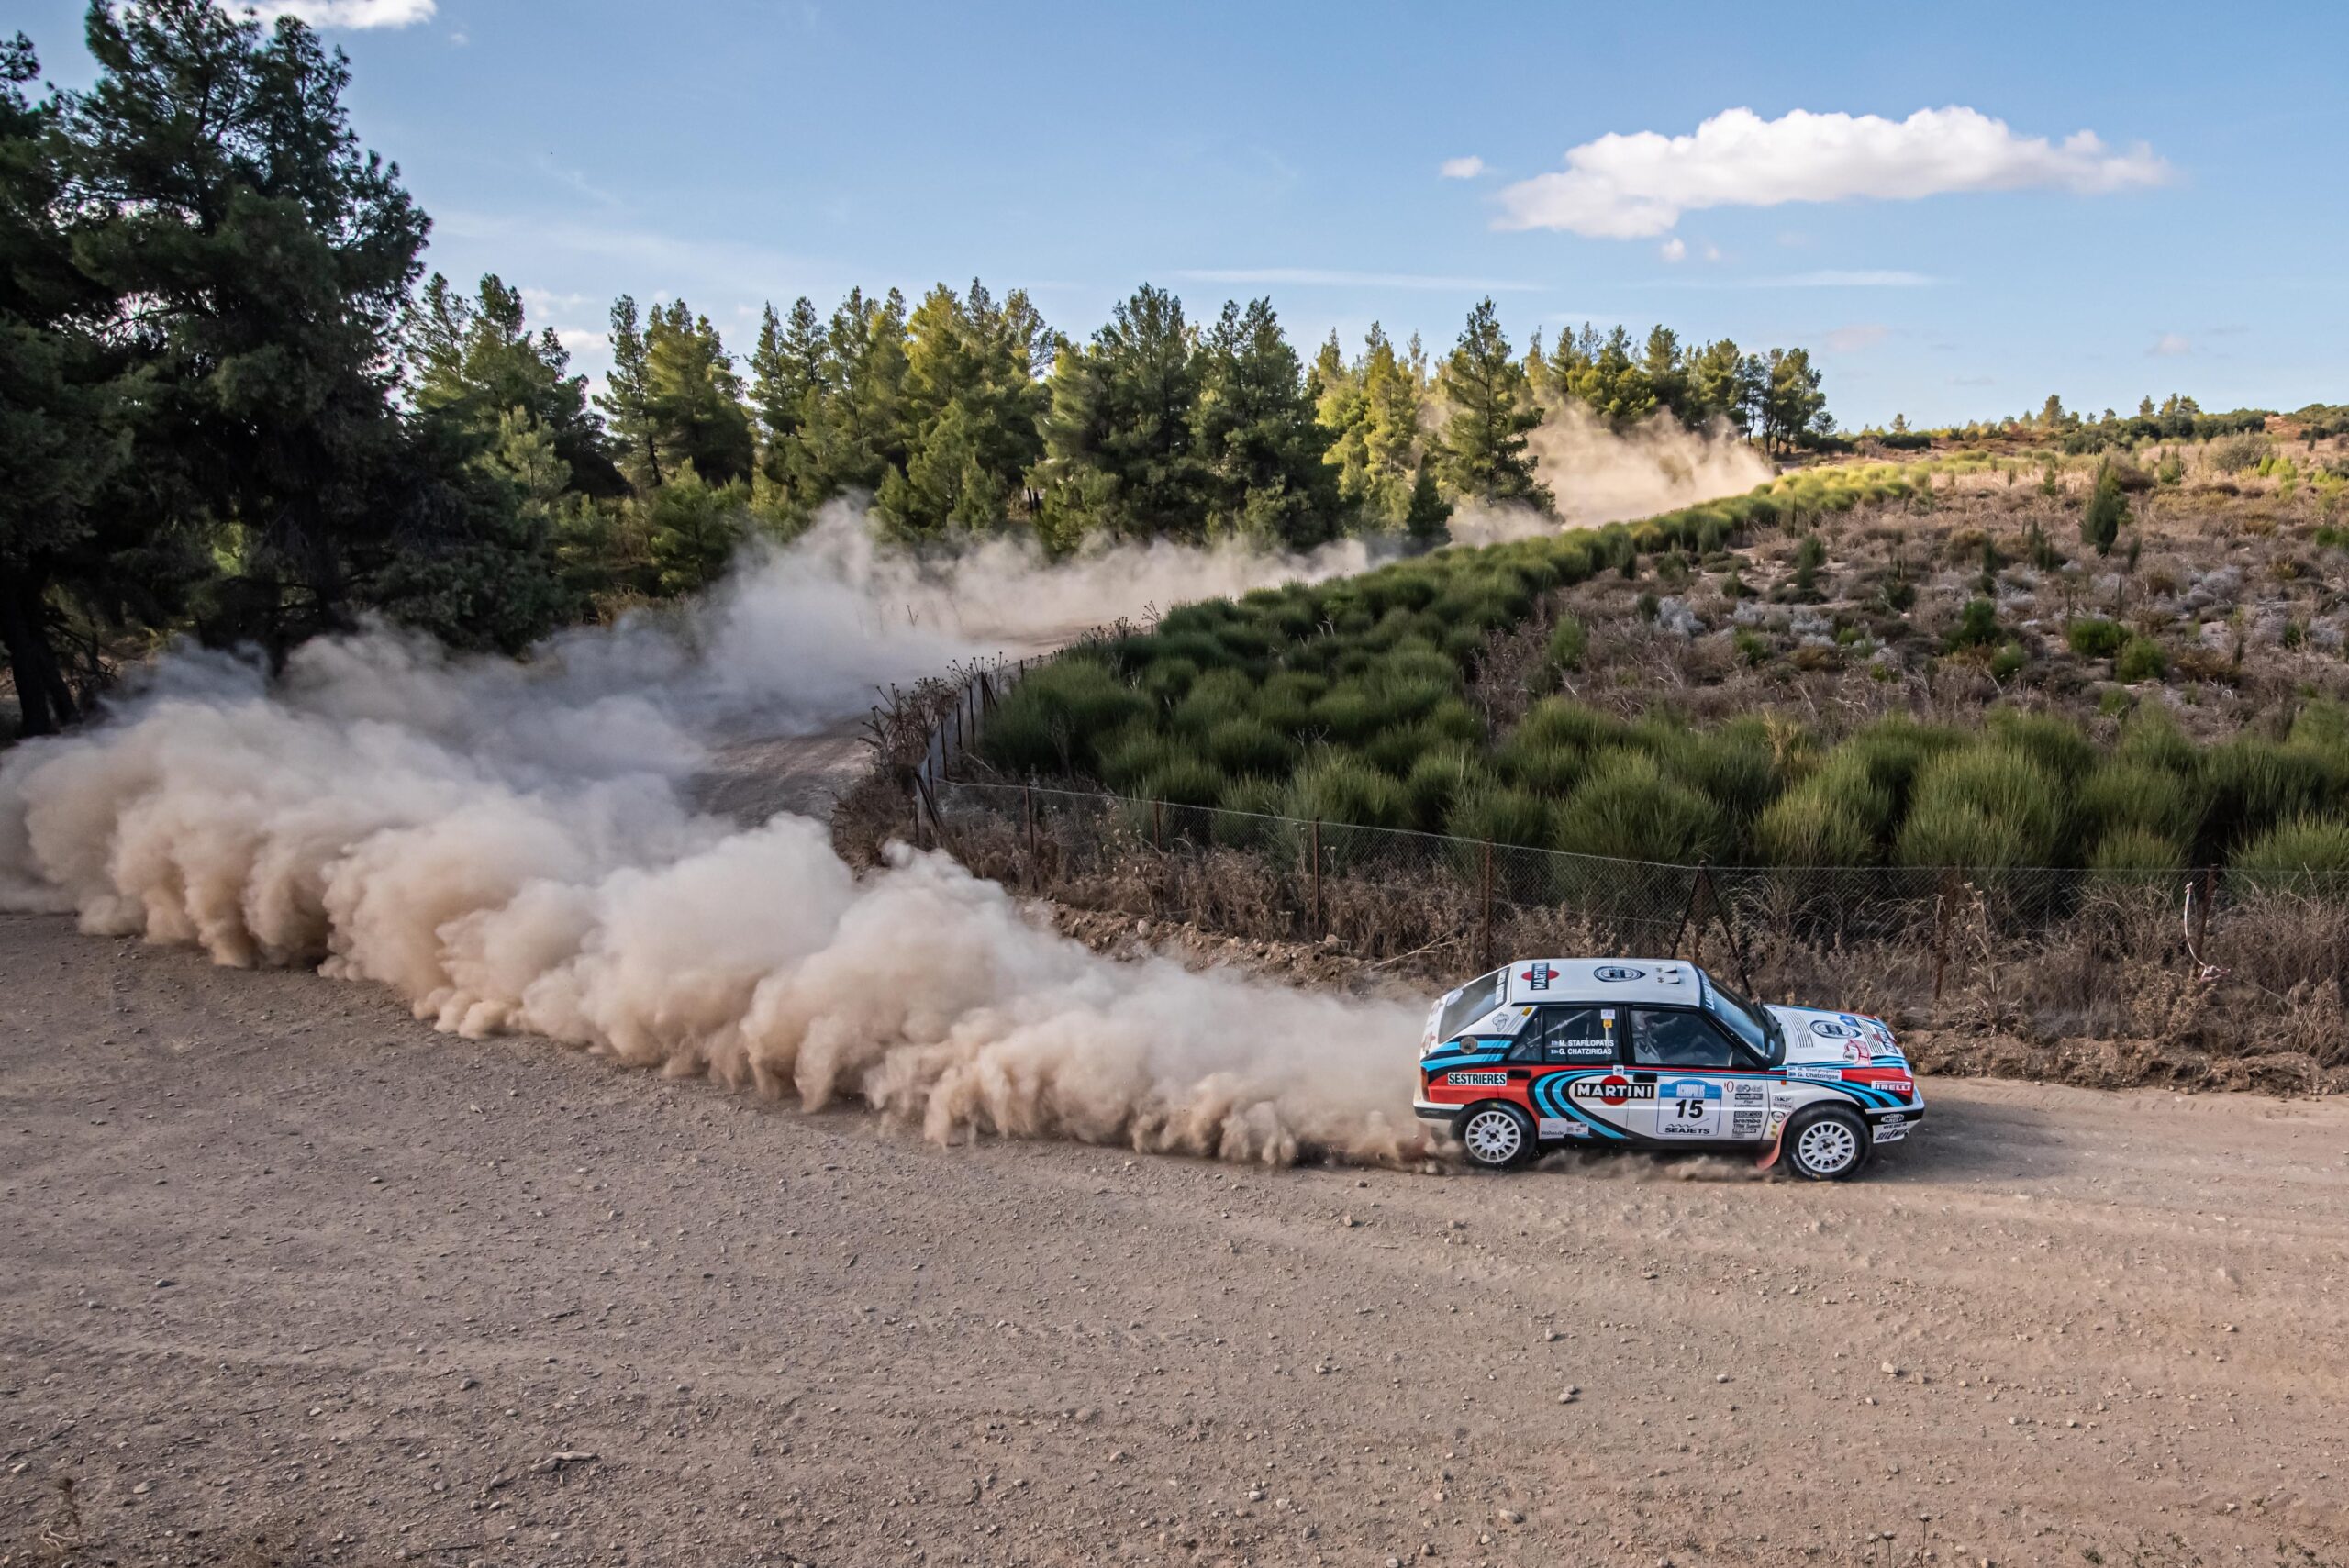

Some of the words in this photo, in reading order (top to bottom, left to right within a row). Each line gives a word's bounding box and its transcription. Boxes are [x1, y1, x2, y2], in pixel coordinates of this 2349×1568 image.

[1448, 1073, 1506, 1085] SESTRIERES
[1577, 1084, 1652, 1097] MARTINI
[1871, 1081, 1911, 1091] PIRELLI
[1675, 1099, 1704, 1118] 15
[1664, 1127, 1710, 1135] SEAJETS
